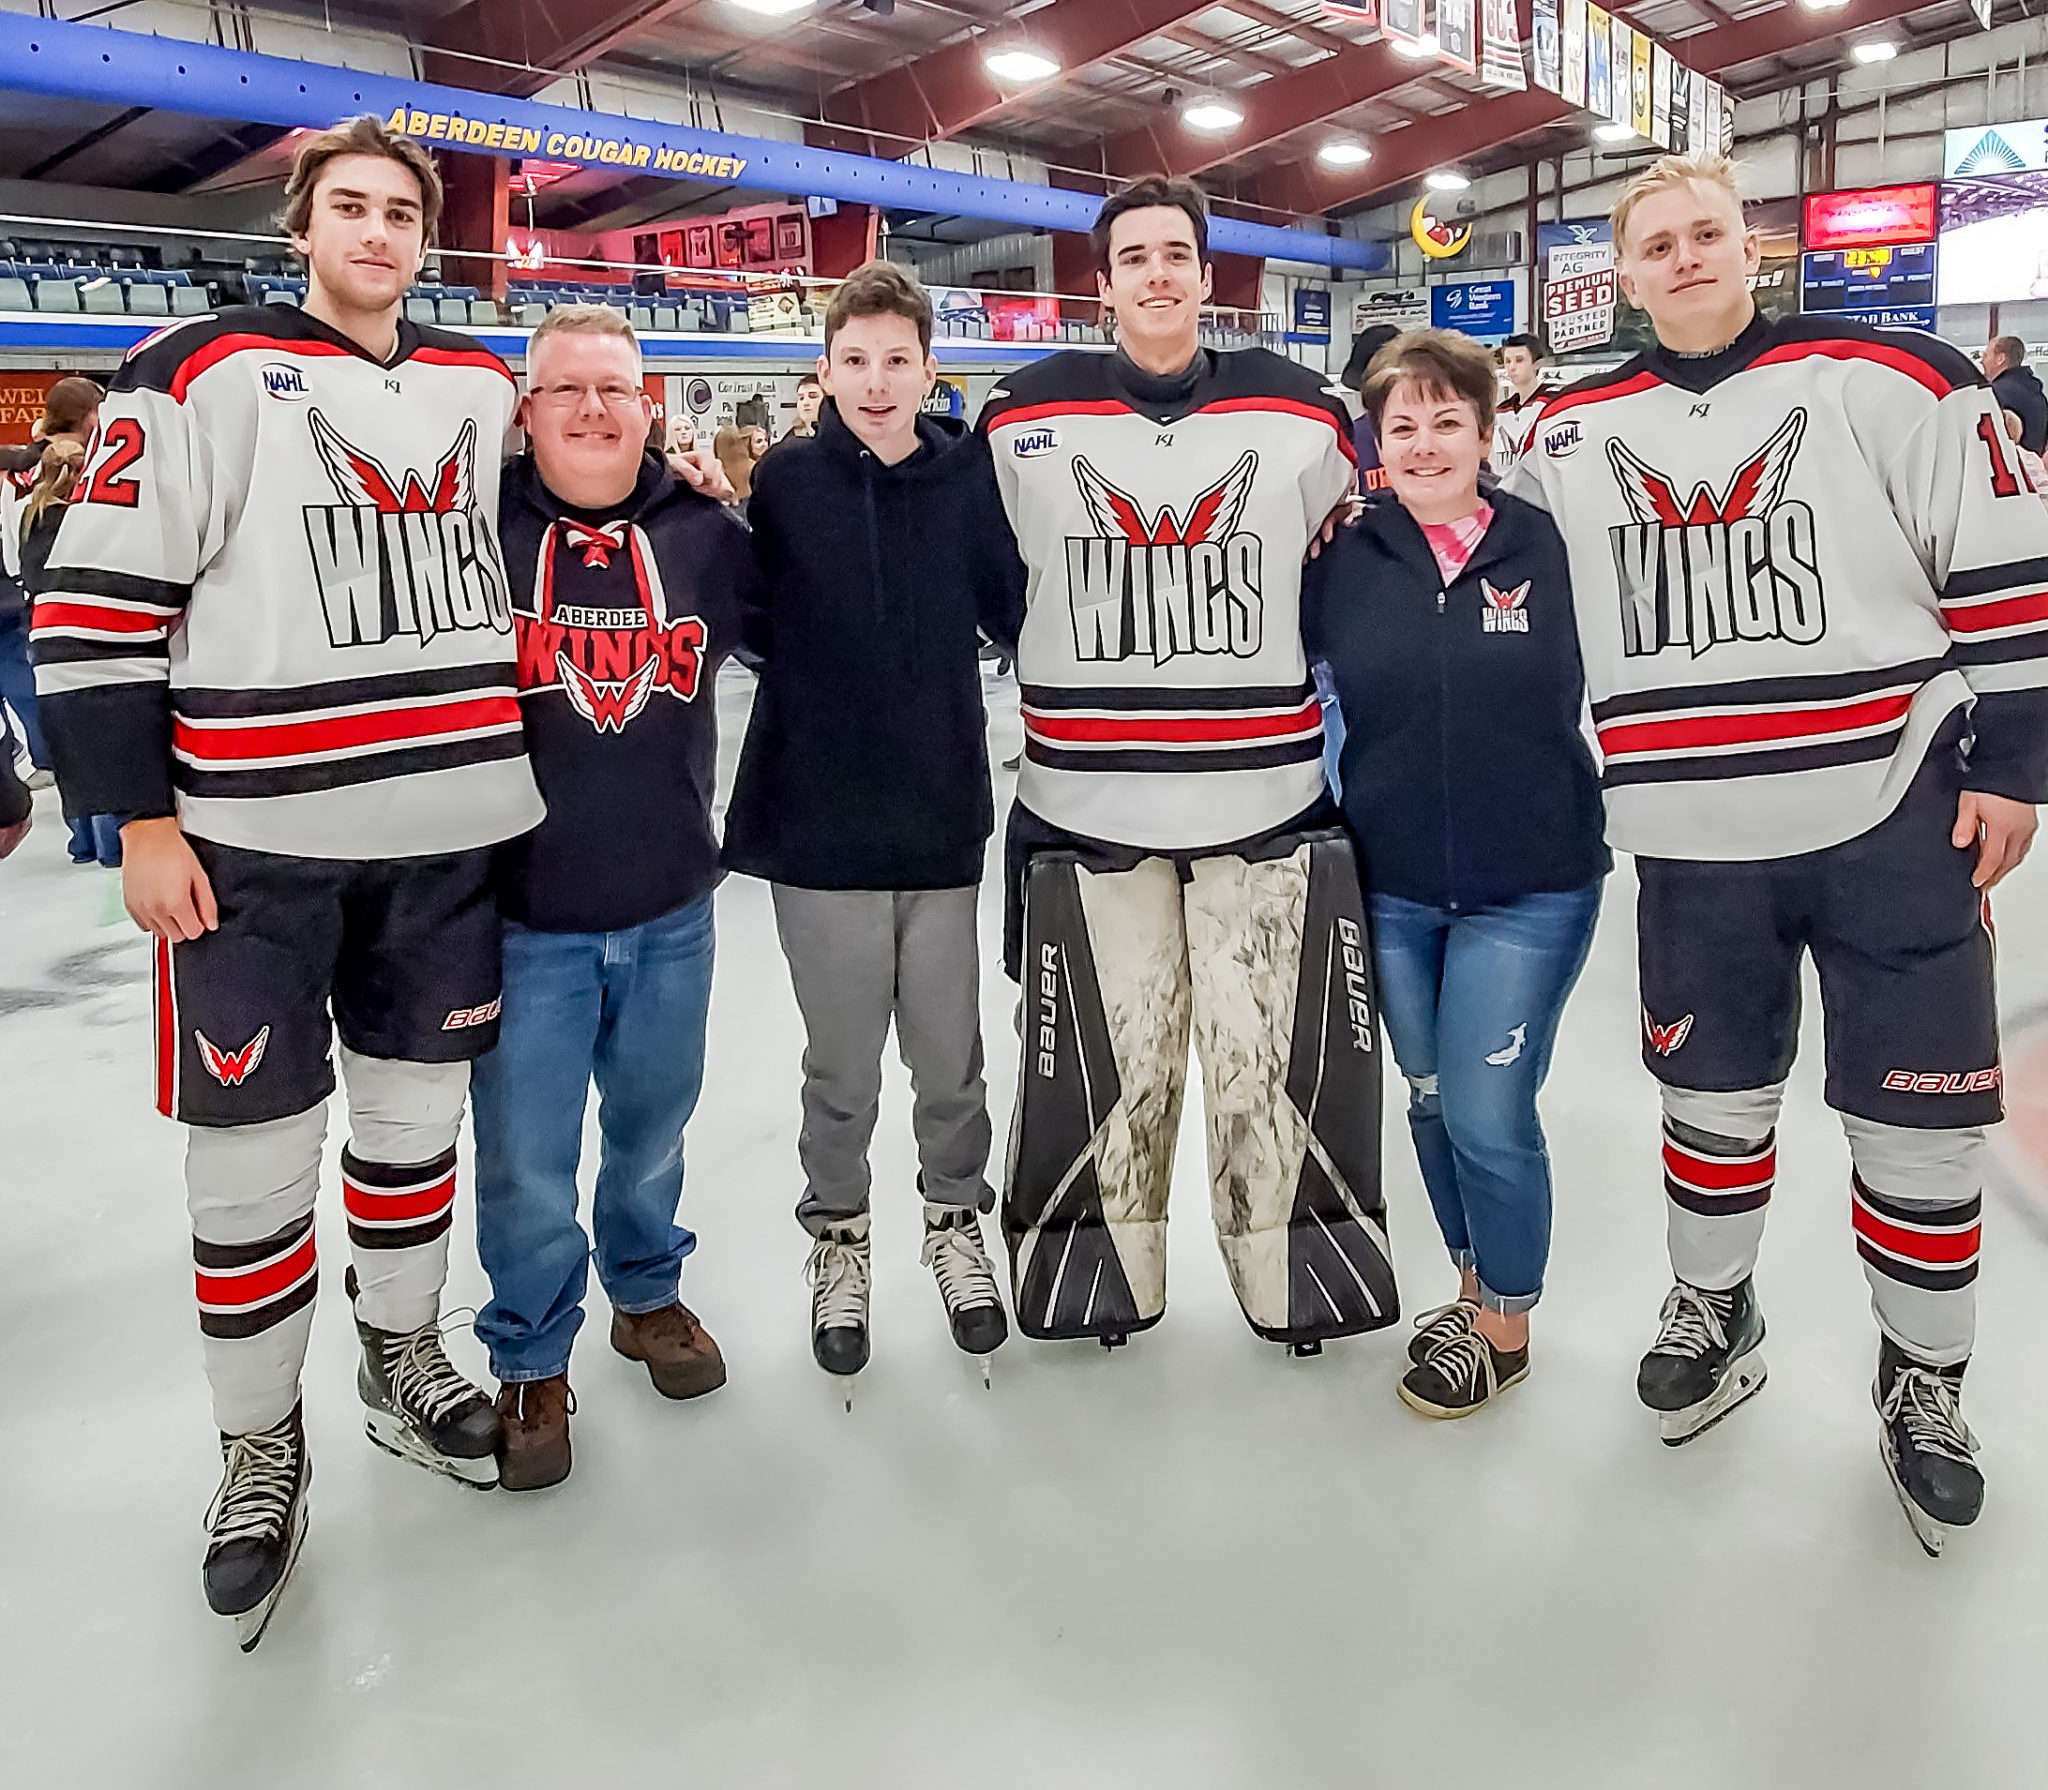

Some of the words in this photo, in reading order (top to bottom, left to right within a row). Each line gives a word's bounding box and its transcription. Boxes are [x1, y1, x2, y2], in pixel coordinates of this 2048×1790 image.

[387, 108, 541, 154] ABERDEEN
[546, 133, 652, 168] COUGAR
[653, 147, 747, 180] HOCKEY
[1553, 250, 1607, 262] INTEGRITY
[1561, 262, 1583, 275] AG
[1547, 271, 1613, 297] PREMIUM
[1548, 284, 1612, 316] SEED
[1553, 309, 1607, 329] TRUSTED
[1881, 311, 1919, 323] BANK
[1554, 320, 1606, 340] PARTNER
[262, 371, 310, 392] NAHL
[0, 388, 47, 405] WEL
[1014, 433, 1058, 453] NAHL
[1544, 425, 1584, 454] NAHL
[302, 503, 513, 649] WINGS
[1608, 499, 1827, 660] WINGS
[1064, 531, 1263, 669] WINGS
[556, 606, 647, 626] ABERDEE
[1482, 606, 1530, 633] WINGS
